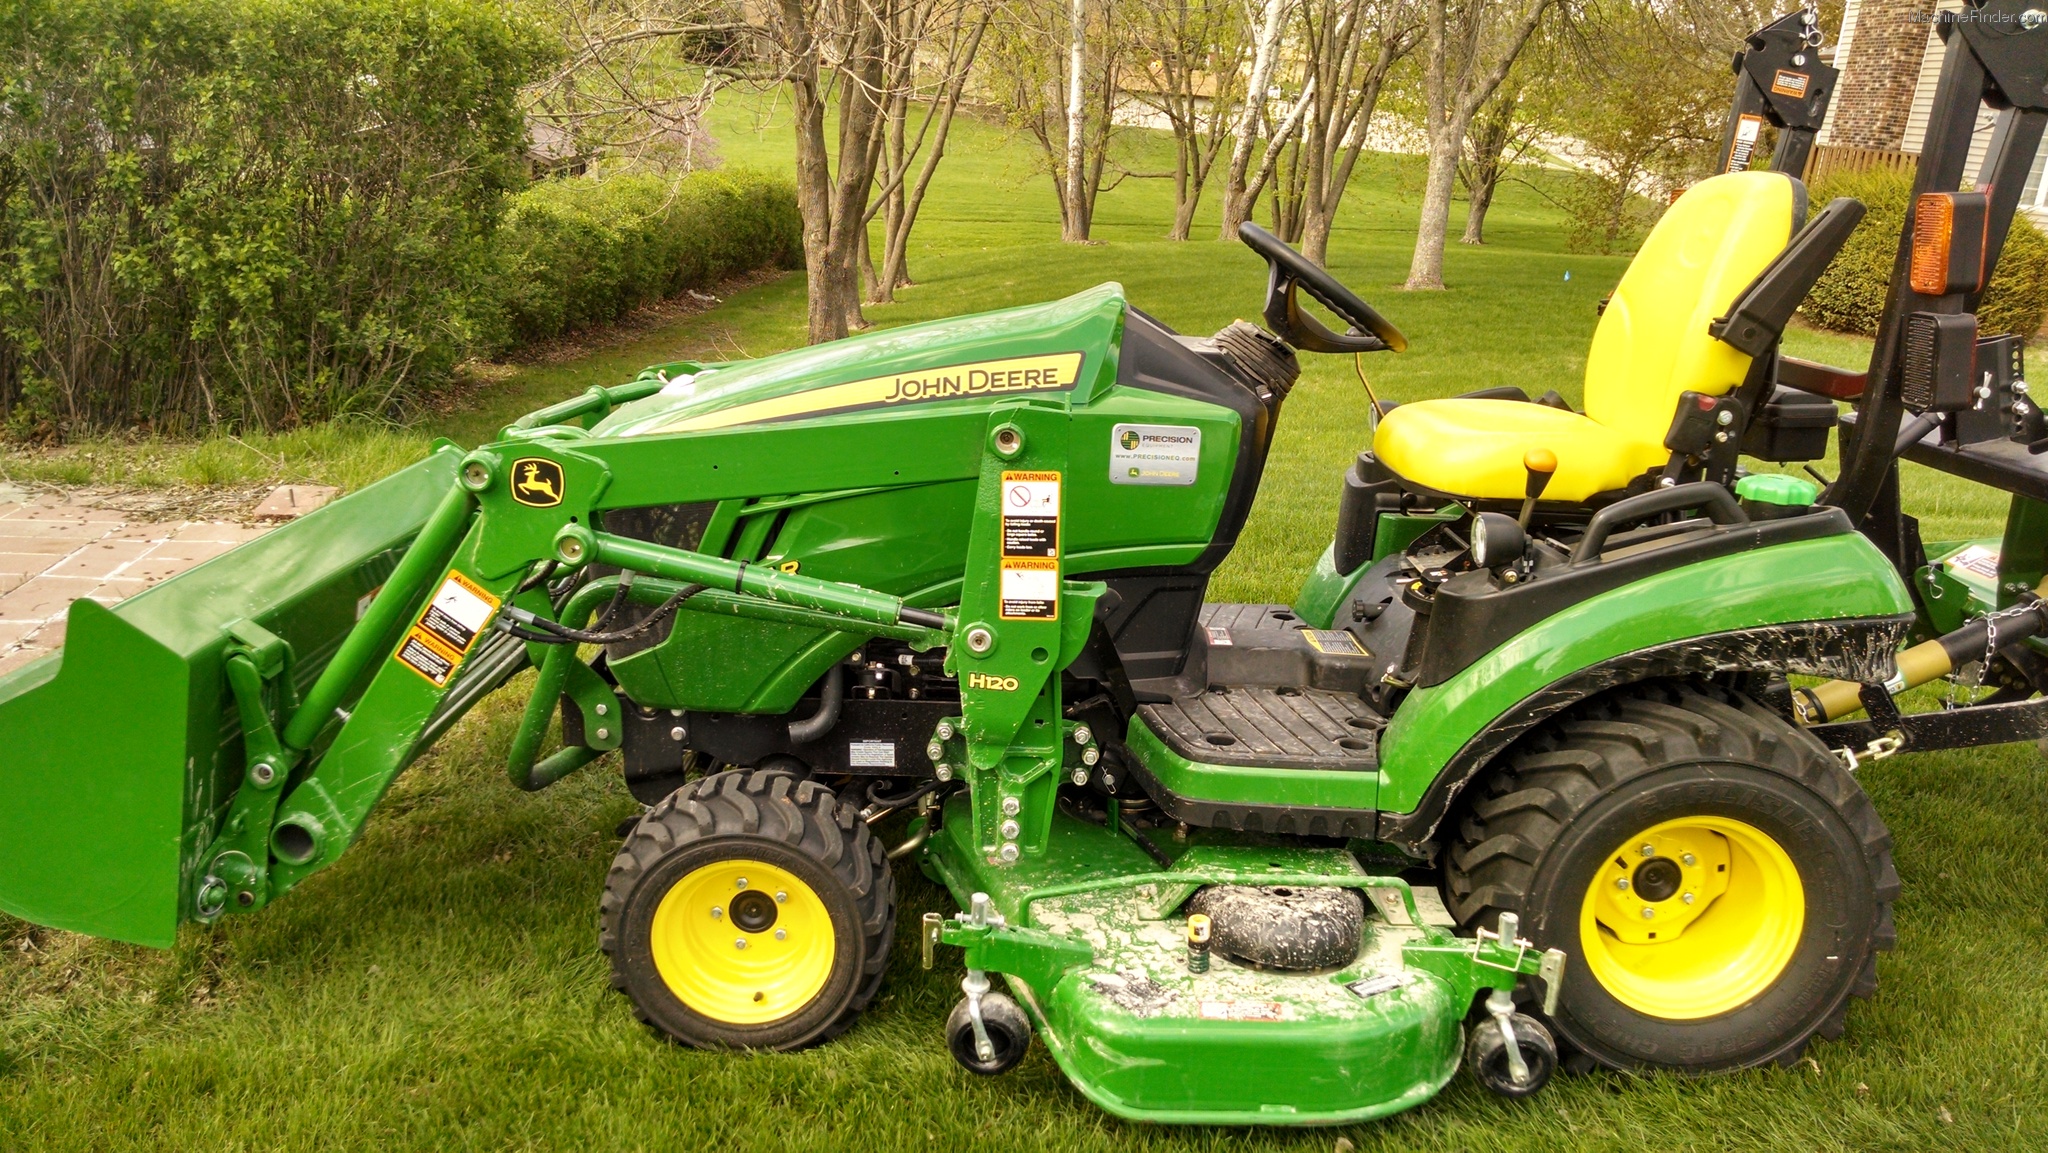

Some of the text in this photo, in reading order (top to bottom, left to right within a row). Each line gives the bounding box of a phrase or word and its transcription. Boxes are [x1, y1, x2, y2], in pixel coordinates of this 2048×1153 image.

[885, 367, 1058, 399] JOHN DEERE
[1142, 434, 1193, 444] PRECISION
[1115, 453, 1196, 461] www.PRECISIONEQ.com
[1014, 473, 1057, 481] WARNING
[1013, 561, 1055, 570] WARNING
[462, 579, 493, 604] WARNING
[424, 637, 455, 661] WARNING
[969, 672, 1019, 692] H120
